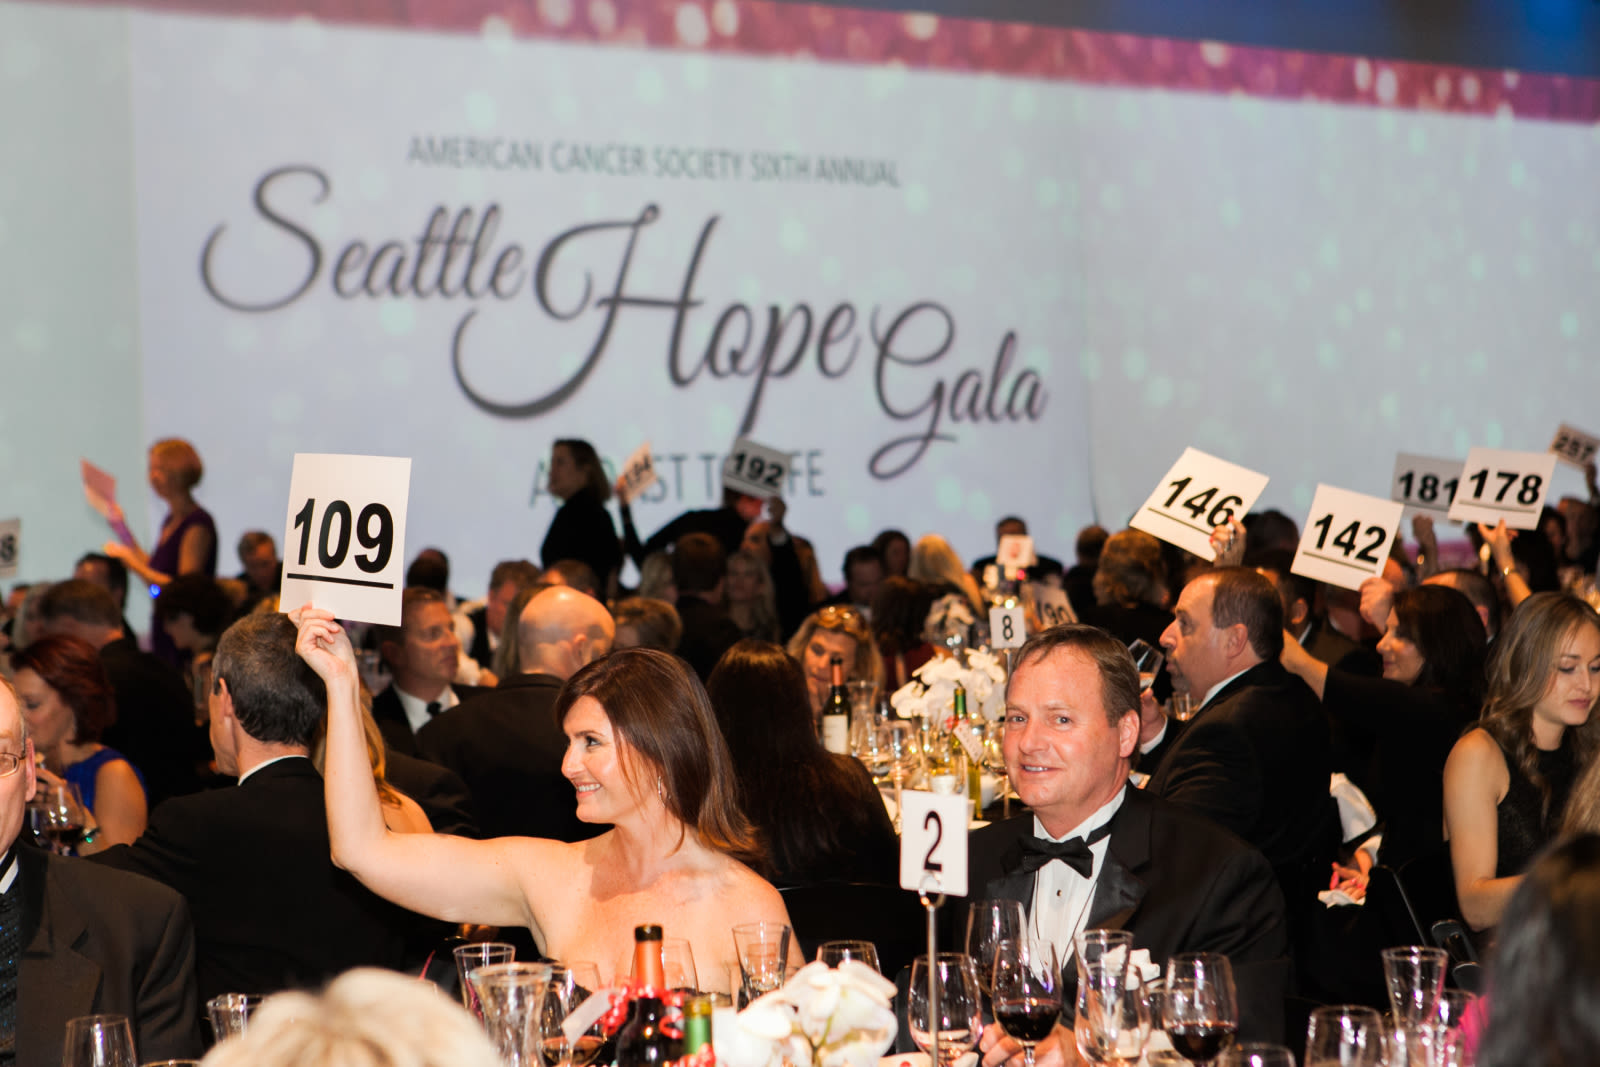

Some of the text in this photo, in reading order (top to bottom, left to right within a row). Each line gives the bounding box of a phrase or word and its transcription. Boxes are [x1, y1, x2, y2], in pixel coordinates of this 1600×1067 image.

[407, 135, 901, 188] AMERICAN CANCER SOCIETY SIXTH ANNUAL
[199, 162, 1047, 480] Seattle Hope Gala
[733, 452, 784, 488] 192
[1398, 470, 1459, 506] 181
[1470, 468, 1543, 505] 178
[1163, 476, 1243, 528] 146
[294, 498, 394, 573] 109
[1314, 514, 1387, 564] 142
[1002, 615, 1014, 640] 8
[923, 810, 943, 872] 2
